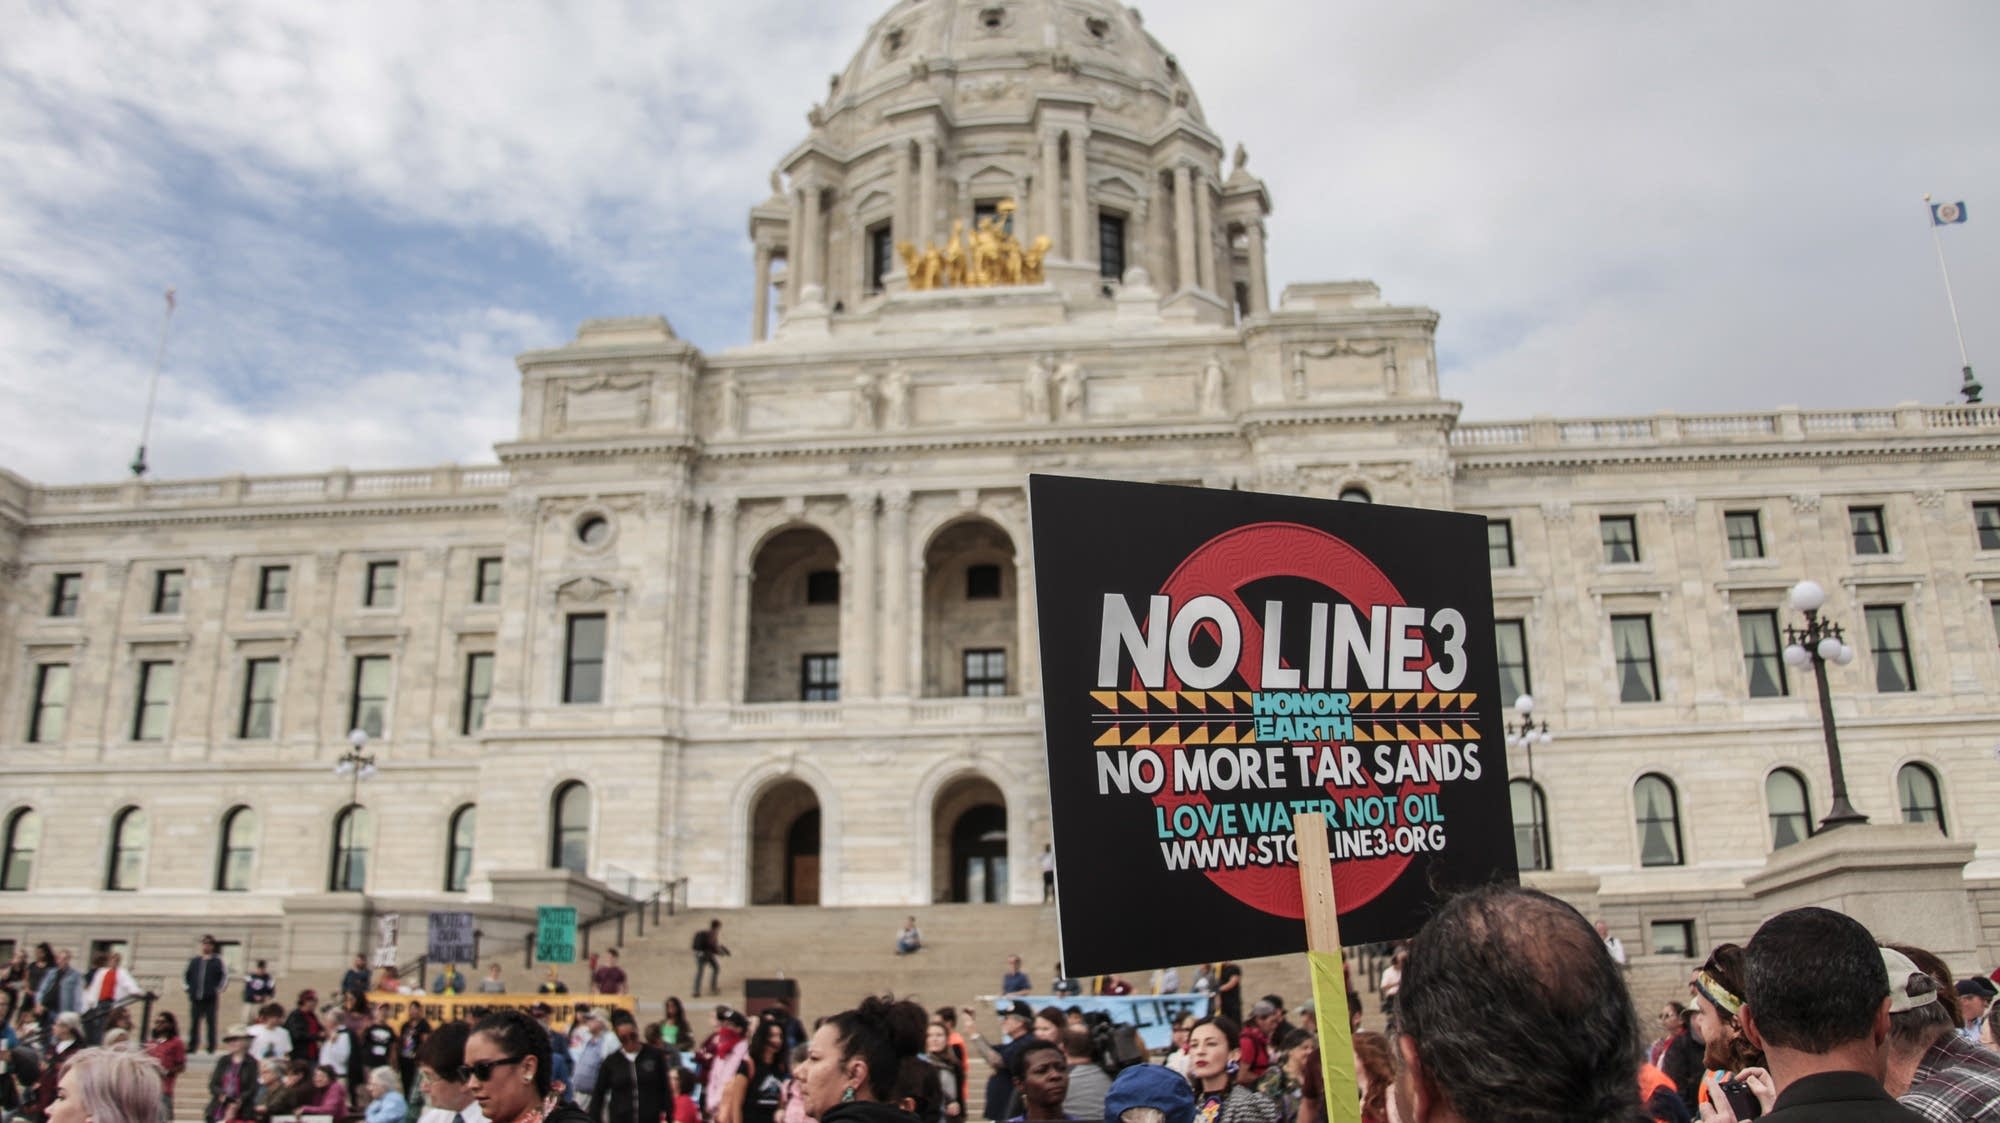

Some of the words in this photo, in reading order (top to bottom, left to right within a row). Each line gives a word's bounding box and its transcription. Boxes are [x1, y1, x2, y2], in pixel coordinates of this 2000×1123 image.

[1097, 592, 1242, 690] NO
[1261, 600, 1468, 692] LINE3
[1252, 691, 1351, 716] HONOR
[1254, 716, 1354, 742] EARTH
[1096, 748, 1165, 795] NO
[1173, 747, 1287, 792] MORE
[1292, 746, 1367, 788] TAR
[1373, 742, 1482, 785] SANDS
[1156, 804, 1238, 839] LOVE
[1344, 796, 1398, 828] NOT
[1403, 794, 1445, 824] OIL
[1159, 824, 1447, 872] WWW.STOINE3.ORG
